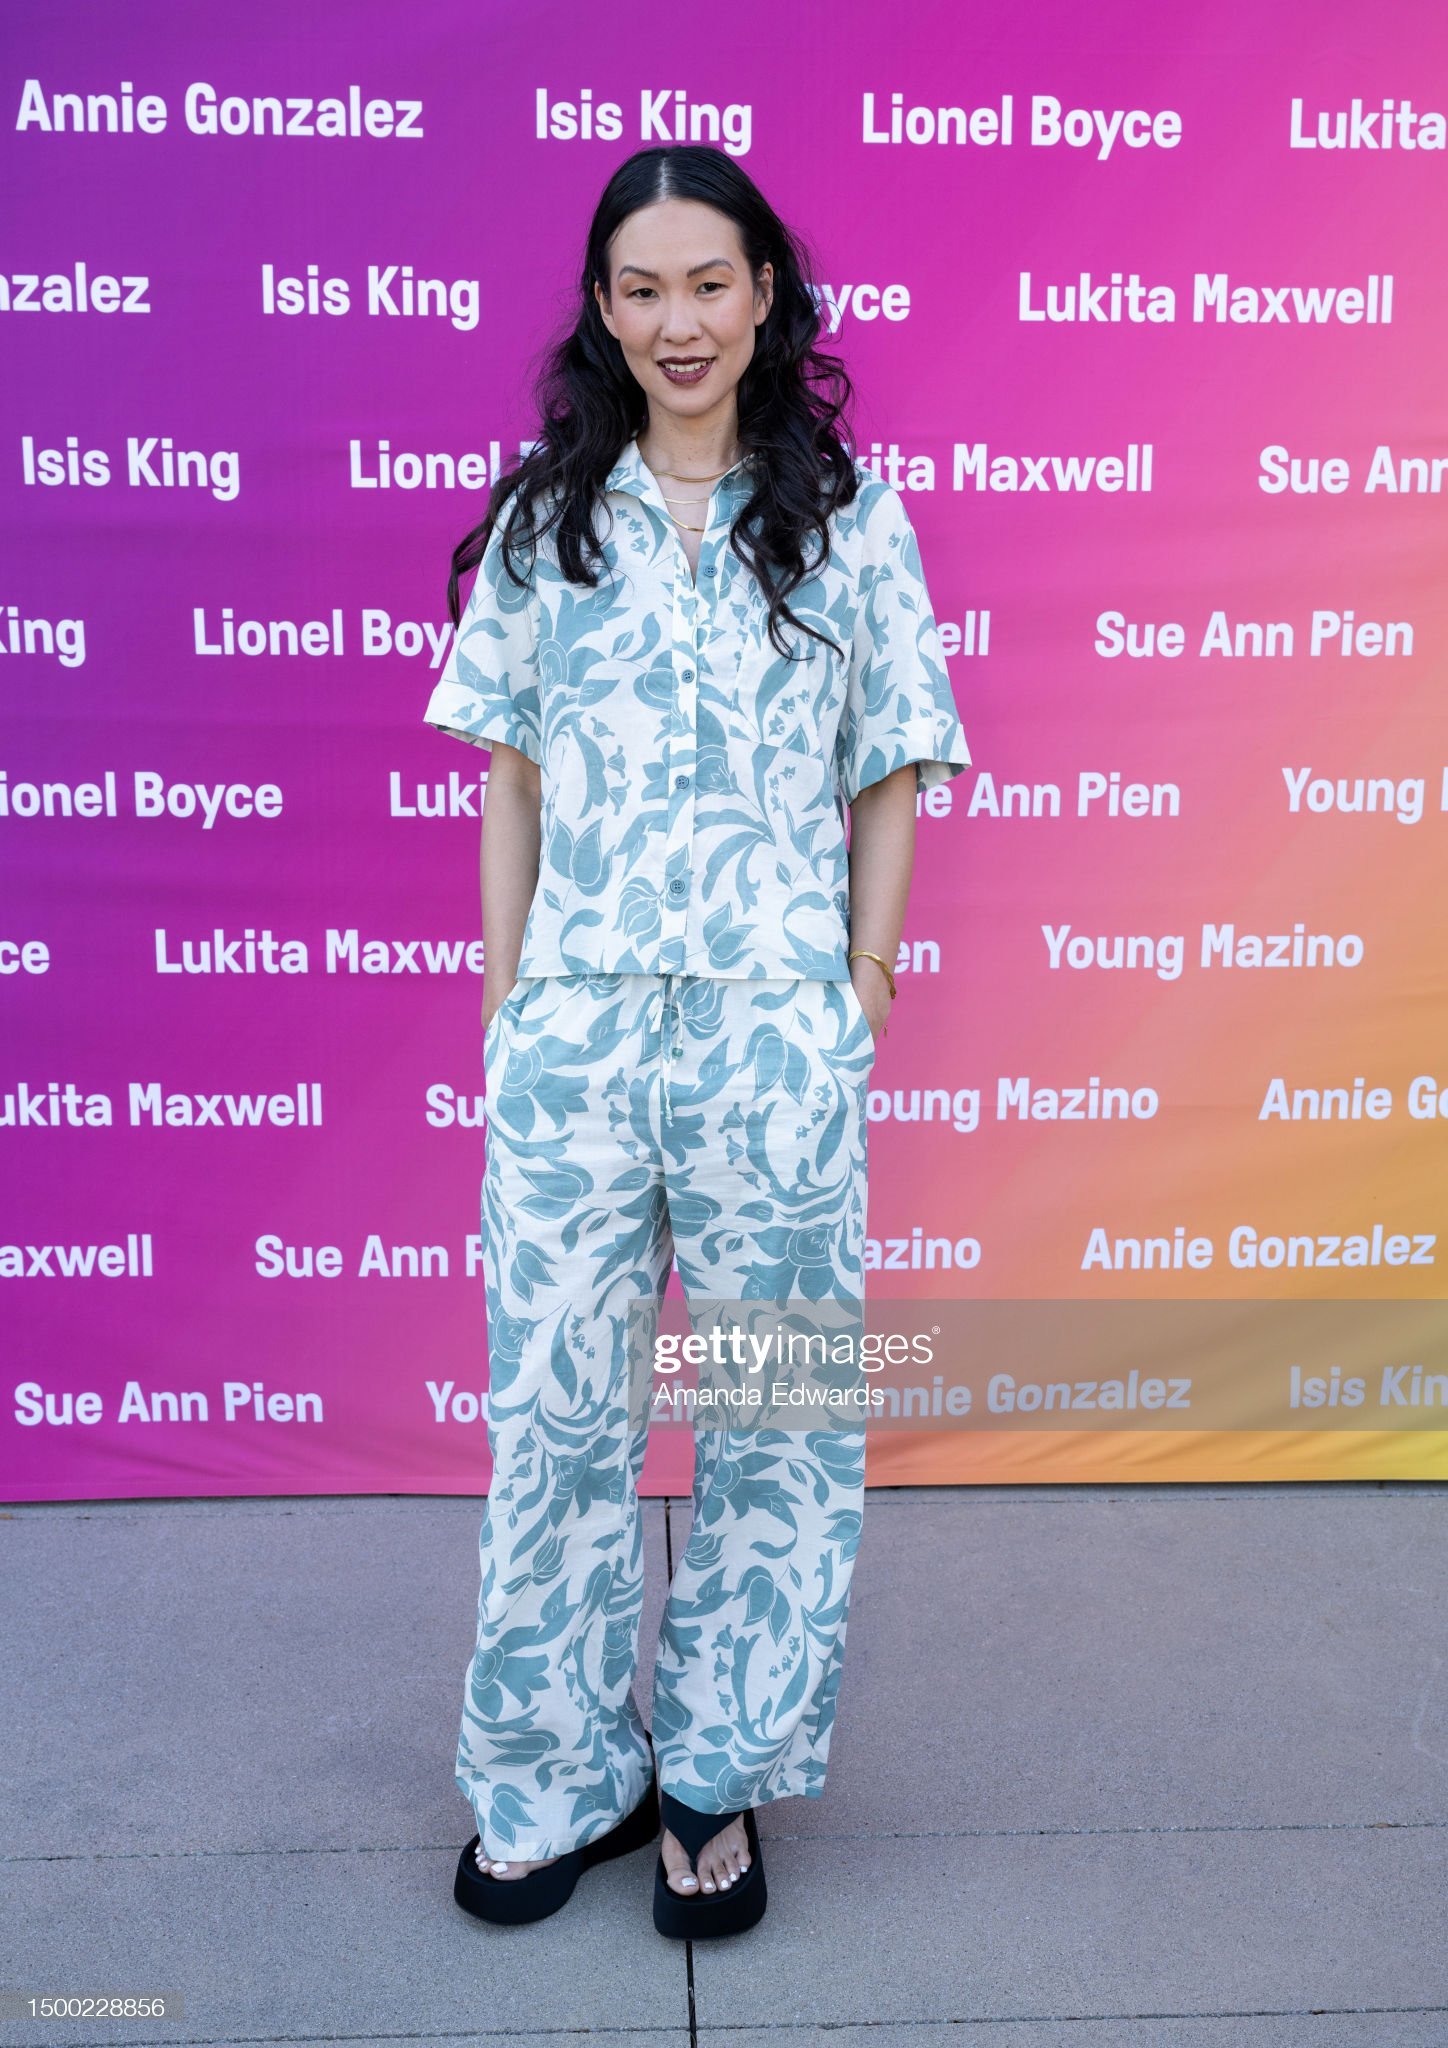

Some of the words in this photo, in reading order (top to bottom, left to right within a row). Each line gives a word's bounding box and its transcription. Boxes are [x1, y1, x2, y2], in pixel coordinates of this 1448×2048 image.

[15, 79, 167, 134] Annie
[185, 82, 424, 138] Gonzalez
[536, 88, 623, 141] Isis
[641, 89, 752, 156] King
[862, 92, 1013, 146] Lionel
[1031, 95, 1182, 161] Boyce
[1290, 98, 1447, 150] Lukita
[262, 264, 350, 316] Isis
[368, 265, 480, 331] King
[1019, 272, 1176, 323] Lukita
[1193, 273, 1394, 324] Maxwell
[22, 436, 111, 487] Isis
[127, 437, 240, 501] King
[350, 441, 501, 489] Lionel
[953, 443, 1153, 493] Maxwell
[1258, 445, 1350, 494] Sue
[193, 608, 344, 656] Lionel
[1094, 610, 1185, 658] Sue
[1199, 611, 1294, 657] Ann
[1309, 610, 1414, 658] Pien
[134, 771, 283, 829] Boyce
[967, 772, 1061, 817] Ann
[1077, 771, 1181, 818] Pien
[1281, 767, 1426, 825] Young
[155, 929, 308, 974] Lukita
[1041, 924, 1185, 981] Young
[1200, 922, 1365, 969] Mazino
[129, 1083, 322, 1127] Maxwell
[996, 1076, 1160, 1121] Mazino
[1257, 1076, 1393, 1121] Annie
[255, 1234, 343, 1278] Sue
[358, 1235, 449, 1277] Ann
[1080, 1226, 1214, 1271] Annie
[1228, 1223, 1437, 1269] Gonzalez
[14, 1382, 103, 1426] Sue
[118, 1381, 208, 1423] Ann
[223, 1382, 323, 1422] Pien
[866, 1375, 972, 1418] nnie
[987, 1370, 1192, 1413] Gonzalez
[1290, 1366, 1366, 1408] Isis
